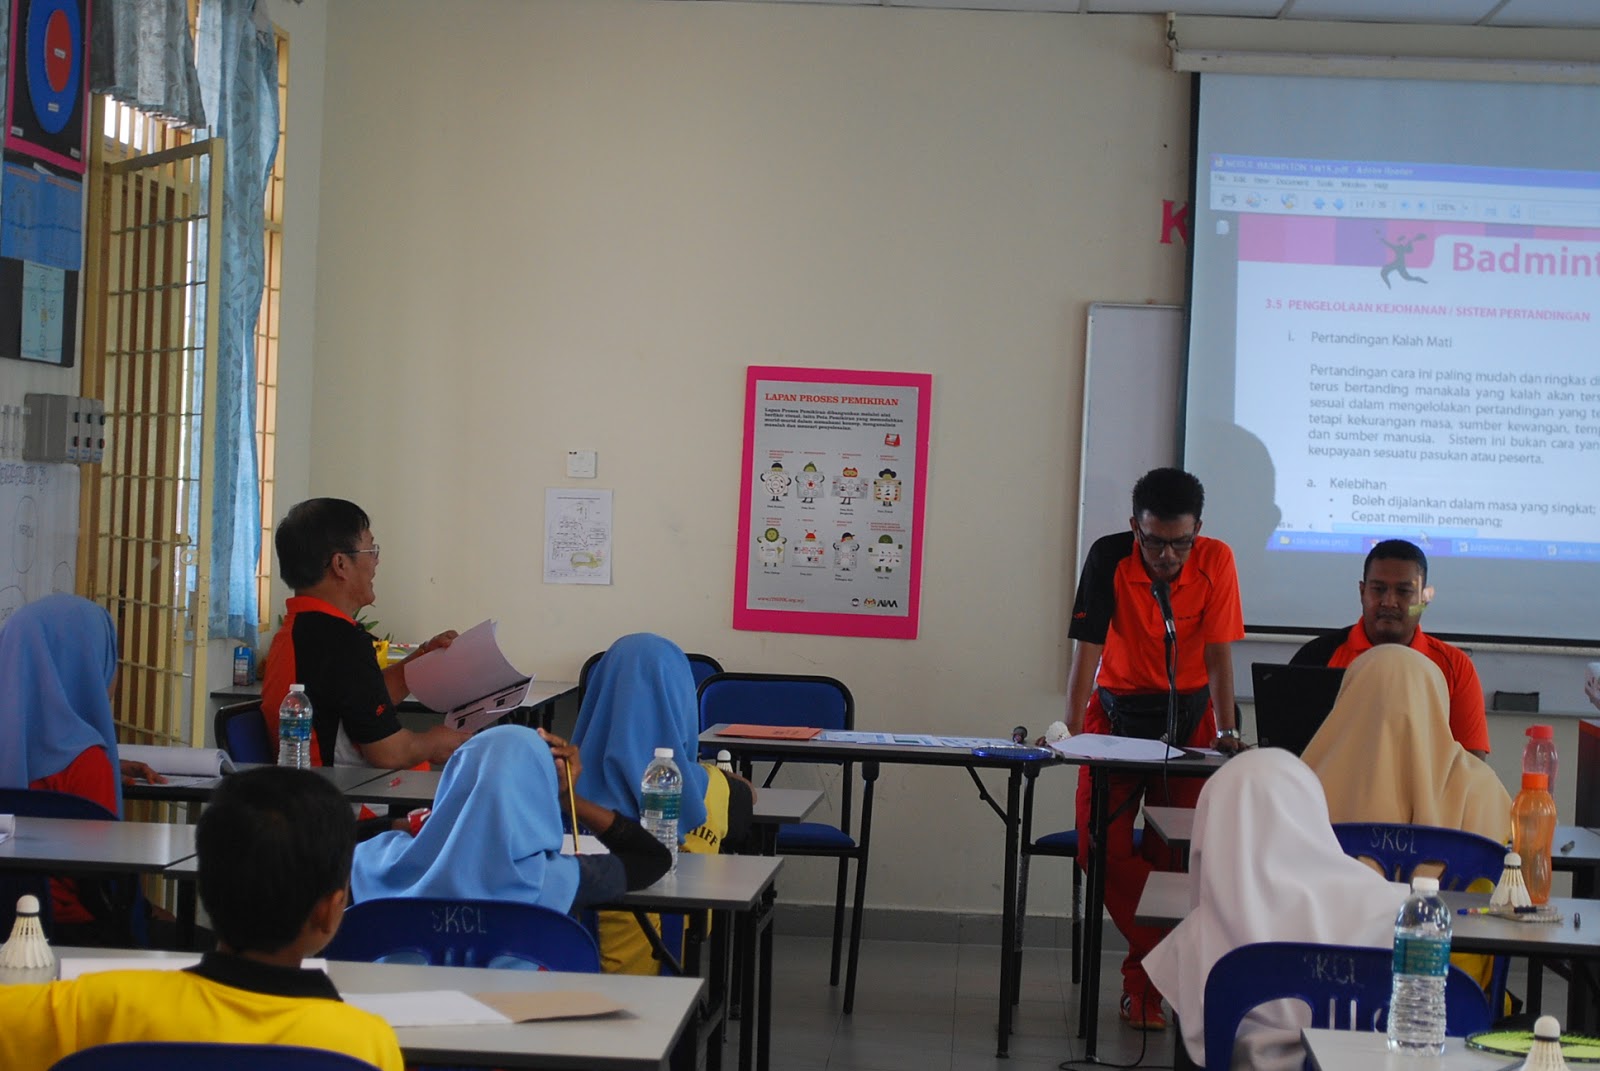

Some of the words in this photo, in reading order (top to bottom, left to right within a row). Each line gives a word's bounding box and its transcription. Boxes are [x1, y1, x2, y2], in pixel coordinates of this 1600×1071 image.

[1265, 299, 1282, 310] 3.5
[1288, 299, 1373, 313] PENGELOLAAN
[1375, 303, 1447, 316] KEJOHANAN
[1456, 306, 1497, 318] SISTEM
[1500, 308, 1591, 322] PERTANDINGAN
[1311, 331, 1389, 347] Pertandingan
[1392, 334, 1423, 347] Kalah
[1427, 336, 1452, 348] Mati
[1310, 364, 1388, 380] Pertandingan
[1391, 369, 1416, 379] cara
[1419, 369, 1433, 379] ini
[1435, 369, 1472, 383] paling
[1476, 370, 1517, 384] mudah
[1519, 373, 1542, 384] dan
[1545, 374, 1586, 387] ringkas
[765, 393, 798, 402] LAPAN
[799, 394, 839, 404] PROSES
[841, 395, 899, 406] PEMIKIRAN
[1310, 381, 1339, 392] terus
[1344, 382, 1409, 397] bertanding
[1415, 384, 1470, 397] manakala
[1476, 389, 1505, 401] yang
[1510, 389, 1541, 400] kalah
[1547, 391, 1575, 401] akan
[1310, 398, 1344, 409] sesuai
[1348, 398, 1384, 410] dalam
[1389, 399, 1471, 414] mengelolakan
[1475, 404, 1554, 419] pertandingan
[1558, 409, 1587, 420] yang
[1308, 413, 1343, 427] tetapi
[1347, 415, 1416, 430] kekurangan
[1420, 418, 1454, 430] masa,
[1458, 419, 1503, 431] sumber
[1507, 420, 1570, 435] kewangan,
[1308, 429, 1331, 440] dan
[1335, 430, 1379, 442] sumber
[1383, 432, 1435, 444] manusia.
[1449, 434, 1487, 446] Sistem
[1491, 436, 1506, 447] ini
[1510, 437, 1547, 449] bukan
[1551, 439, 1575, 450] cara
[1308, 444, 1370, 460] keupayaan
[1373, 448, 1417, 460] sesuatu
[1420, 450, 1468, 463] pasukan
[1470, 452, 1496, 463] atau
[1499, 454, 1544, 465] peserta.
[1306, 477, 1317, 488] a.
[1330, 477, 1388, 491] Kelebihan
[1352, 494, 1386, 507] Boleh
[1387, 496, 1447, 511] dijalankan
[1449, 498, 1486, 511] dalam
[1488, 501, 1518, 512] masa
[1520, 503, 1549, 515] yang
[1552, 503, 1597, 516] singkat;
[1351, 510, 1385, 524] Cepat
[1388, 513, 1435, 525] memilih
[1438, 516, 1503, 529] pemenang;
[1370, 826, 1418, 855] SKCL
